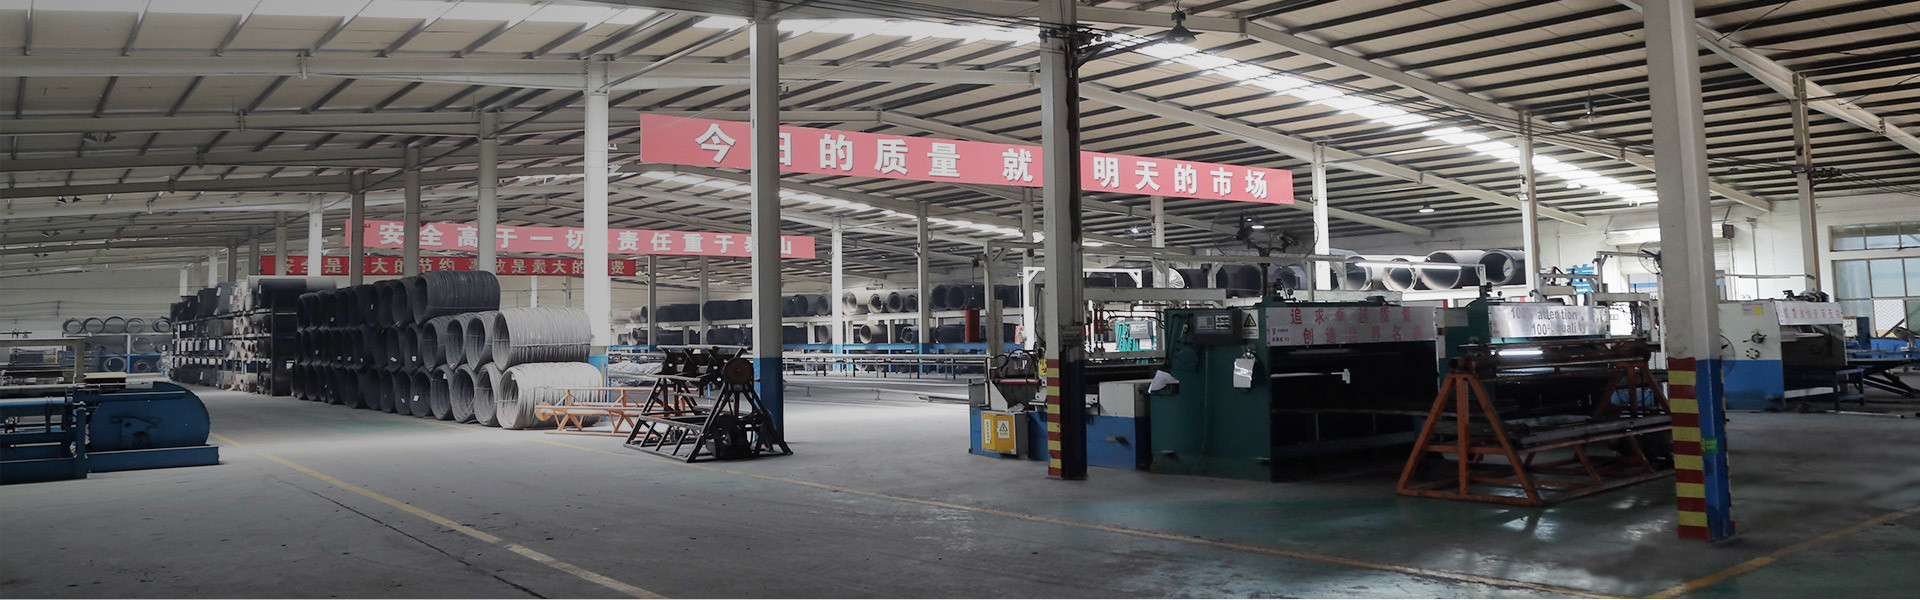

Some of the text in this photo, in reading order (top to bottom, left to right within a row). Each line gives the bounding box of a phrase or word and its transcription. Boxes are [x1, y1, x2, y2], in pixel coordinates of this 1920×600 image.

[1001, 147, 1269, 200] 就明天的市场
[1302, 324, 1423, 346] 创造世界名
